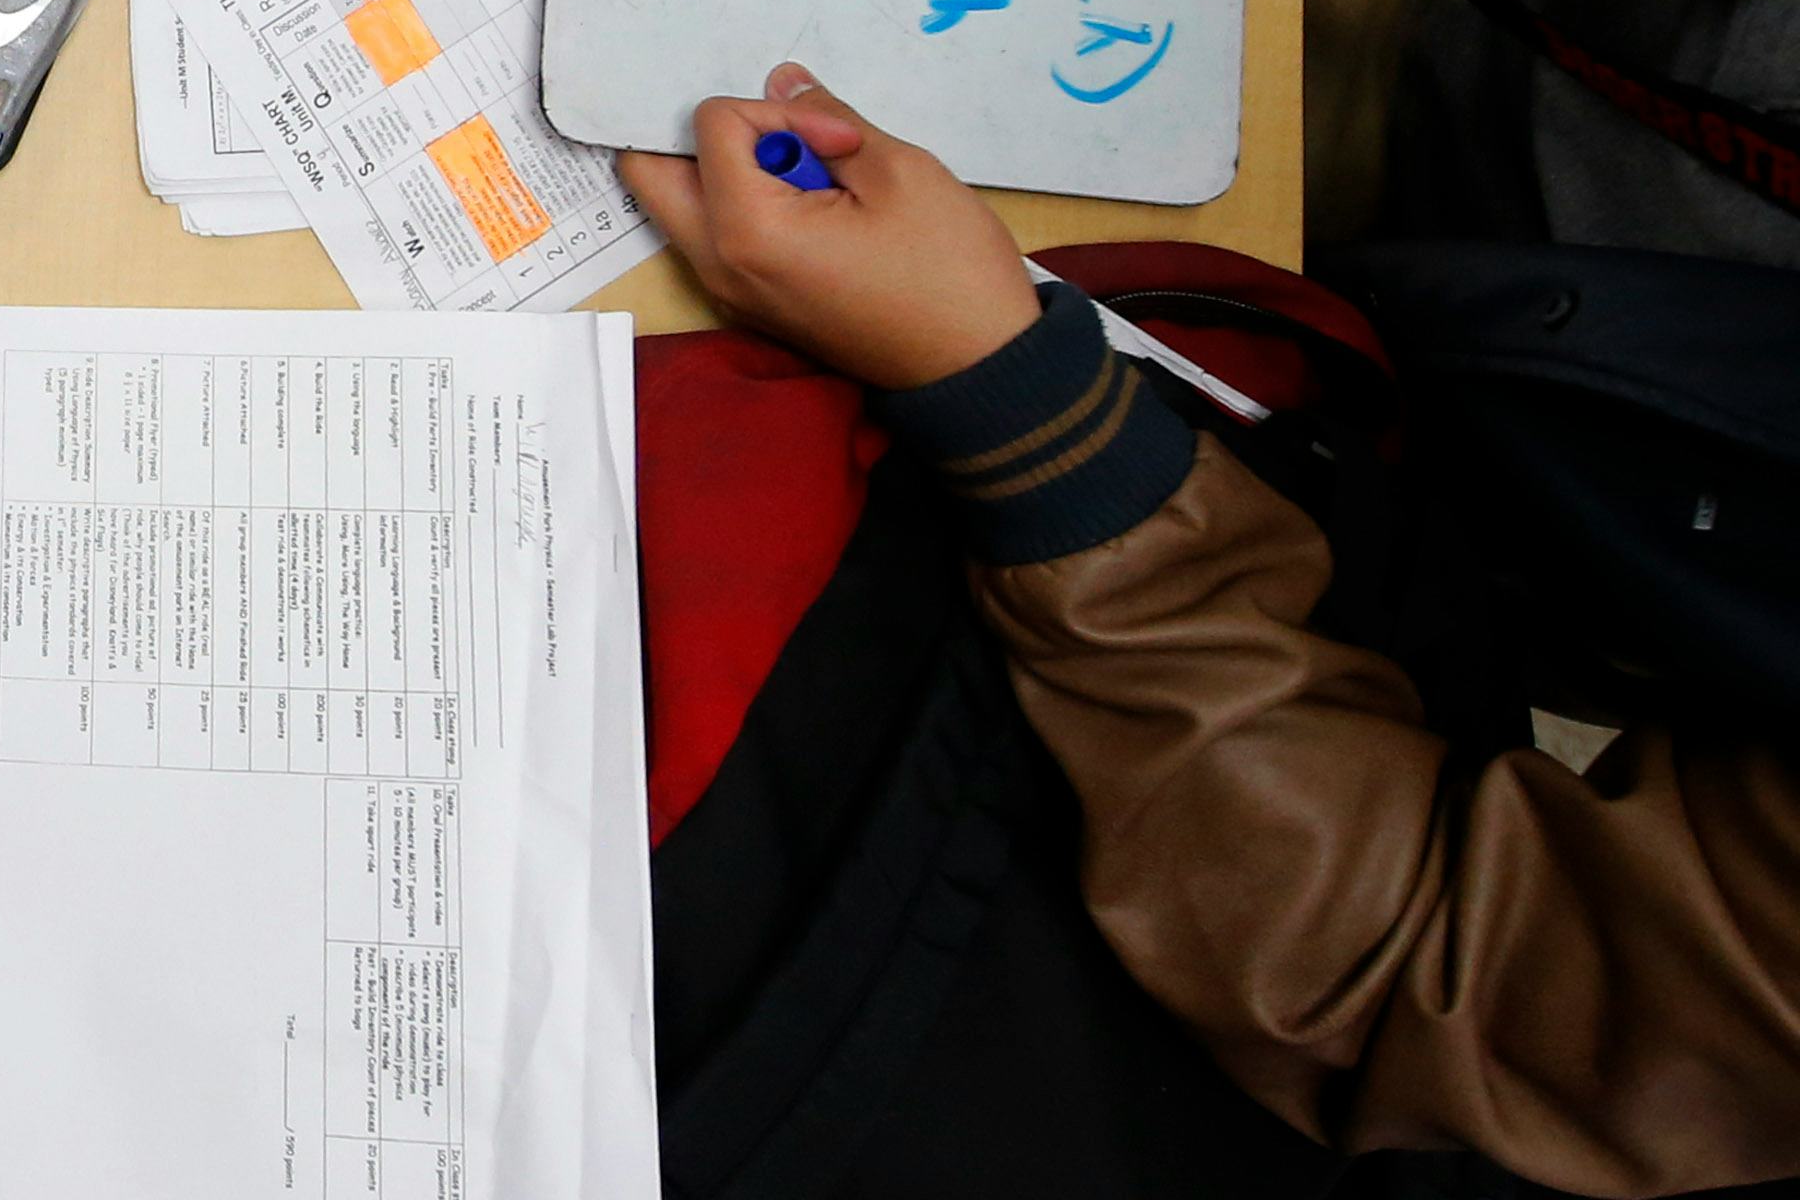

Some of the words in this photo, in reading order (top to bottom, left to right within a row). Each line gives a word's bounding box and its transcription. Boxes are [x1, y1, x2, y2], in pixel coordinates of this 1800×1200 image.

[271, 2, 321, 37] Discussion
[293, 24, 318, 42] Date
[175, 26, 186, 64] Student
[280, 84, 297, 105] M,
[303, 61, 332, 109] Question
[261, 99, 299, 146] CHART
[290, 101, 314, 132] Unit
[341, 123, 375, 177] Summarize
[594, 209, 612, 231] 4a
[402, 220, 425, 259] Watch
[545, 245, 564, 261] 2
[569, 230, 587, 246] 3
[438, 360, 449, 392] Tasks
[427, 396, 439, 420] Build
[466, 394, 475, 420] Name
[492, 394, 501, 419] Team
[516, 393, 524, 420] Name
[467, 421, 476, 433] of
[467, 434, 477, 455] Ride
[493, 421, 502, 465] Members:
[427, 448, 440, 493] Inventory
[467, 457, 478, 513] Constructed
[541, 458, 551, 510] Amusement
[542, 511, 553, 533] Park
[439, 513, 451, 570] Description
[543, 533, 553, 568] Physics
[545, 578, 556, 622] Semester
[546, 623, 556, 641] Lab
[545, 642, 557, 677] Project
[433, 696, 443, 709] 20
[431, 711, 442, 740] points
[285, 1013, 296, 1040] Total
